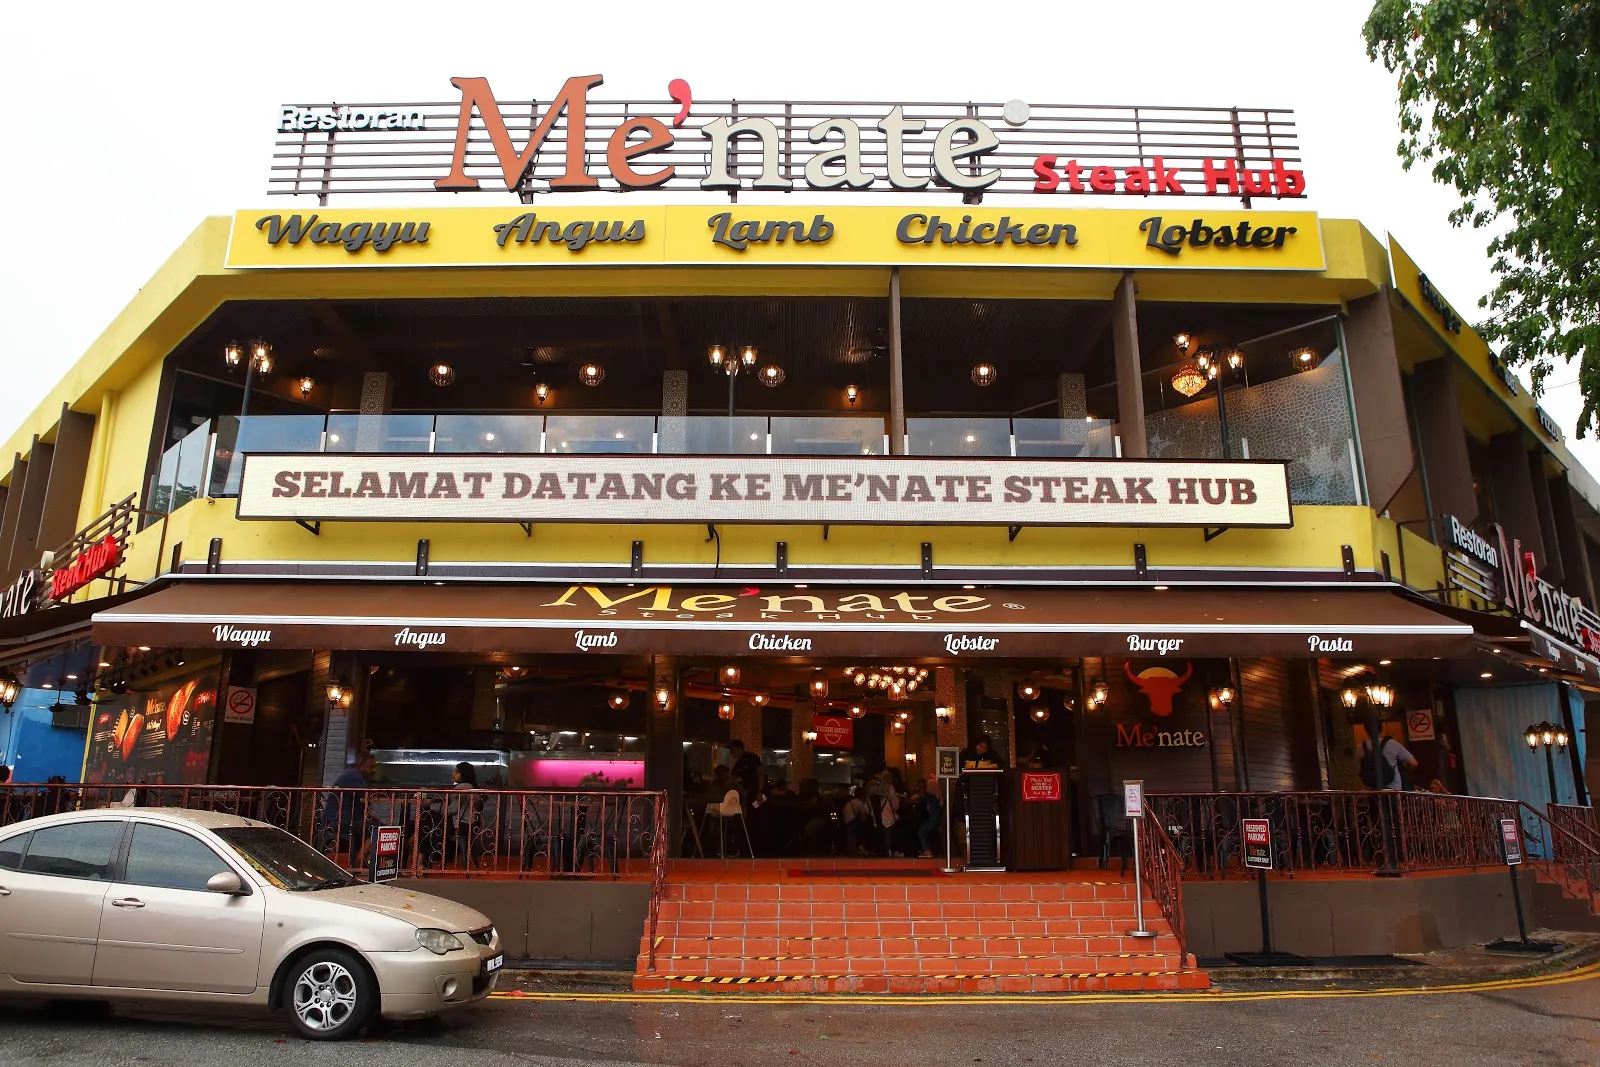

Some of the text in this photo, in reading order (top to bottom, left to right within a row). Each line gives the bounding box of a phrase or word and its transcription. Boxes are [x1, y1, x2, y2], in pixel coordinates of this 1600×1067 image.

[276, 104, 426, 133] Restoran
[433, 74, 1001, 192] Me'nate
[1032, 155, 1306, 198] Steak Hub
[255, 212, 1298, 256] Wagyu Angus Lamb Chicken Lobster
[271, 469, 1259, 506] SELAMAT DATANG KE ME'NATE STEAK HUB
[1451, 515, 1499, 569] Restoran
[540, 584, 992, 613] Me'nate
[212, 625, 1353, 656] Wagyu Angus Lamb Chicken Lobster Burger Pasta
[1115, 722, 1205, 748] Me'nate
[380, 832, 398, 841] RESERVED
[1245, 824, 1267, 832] RESERVED
[1247, 833, 1266, 841] PARKING
[380, 842, 397, 851] PARKING
